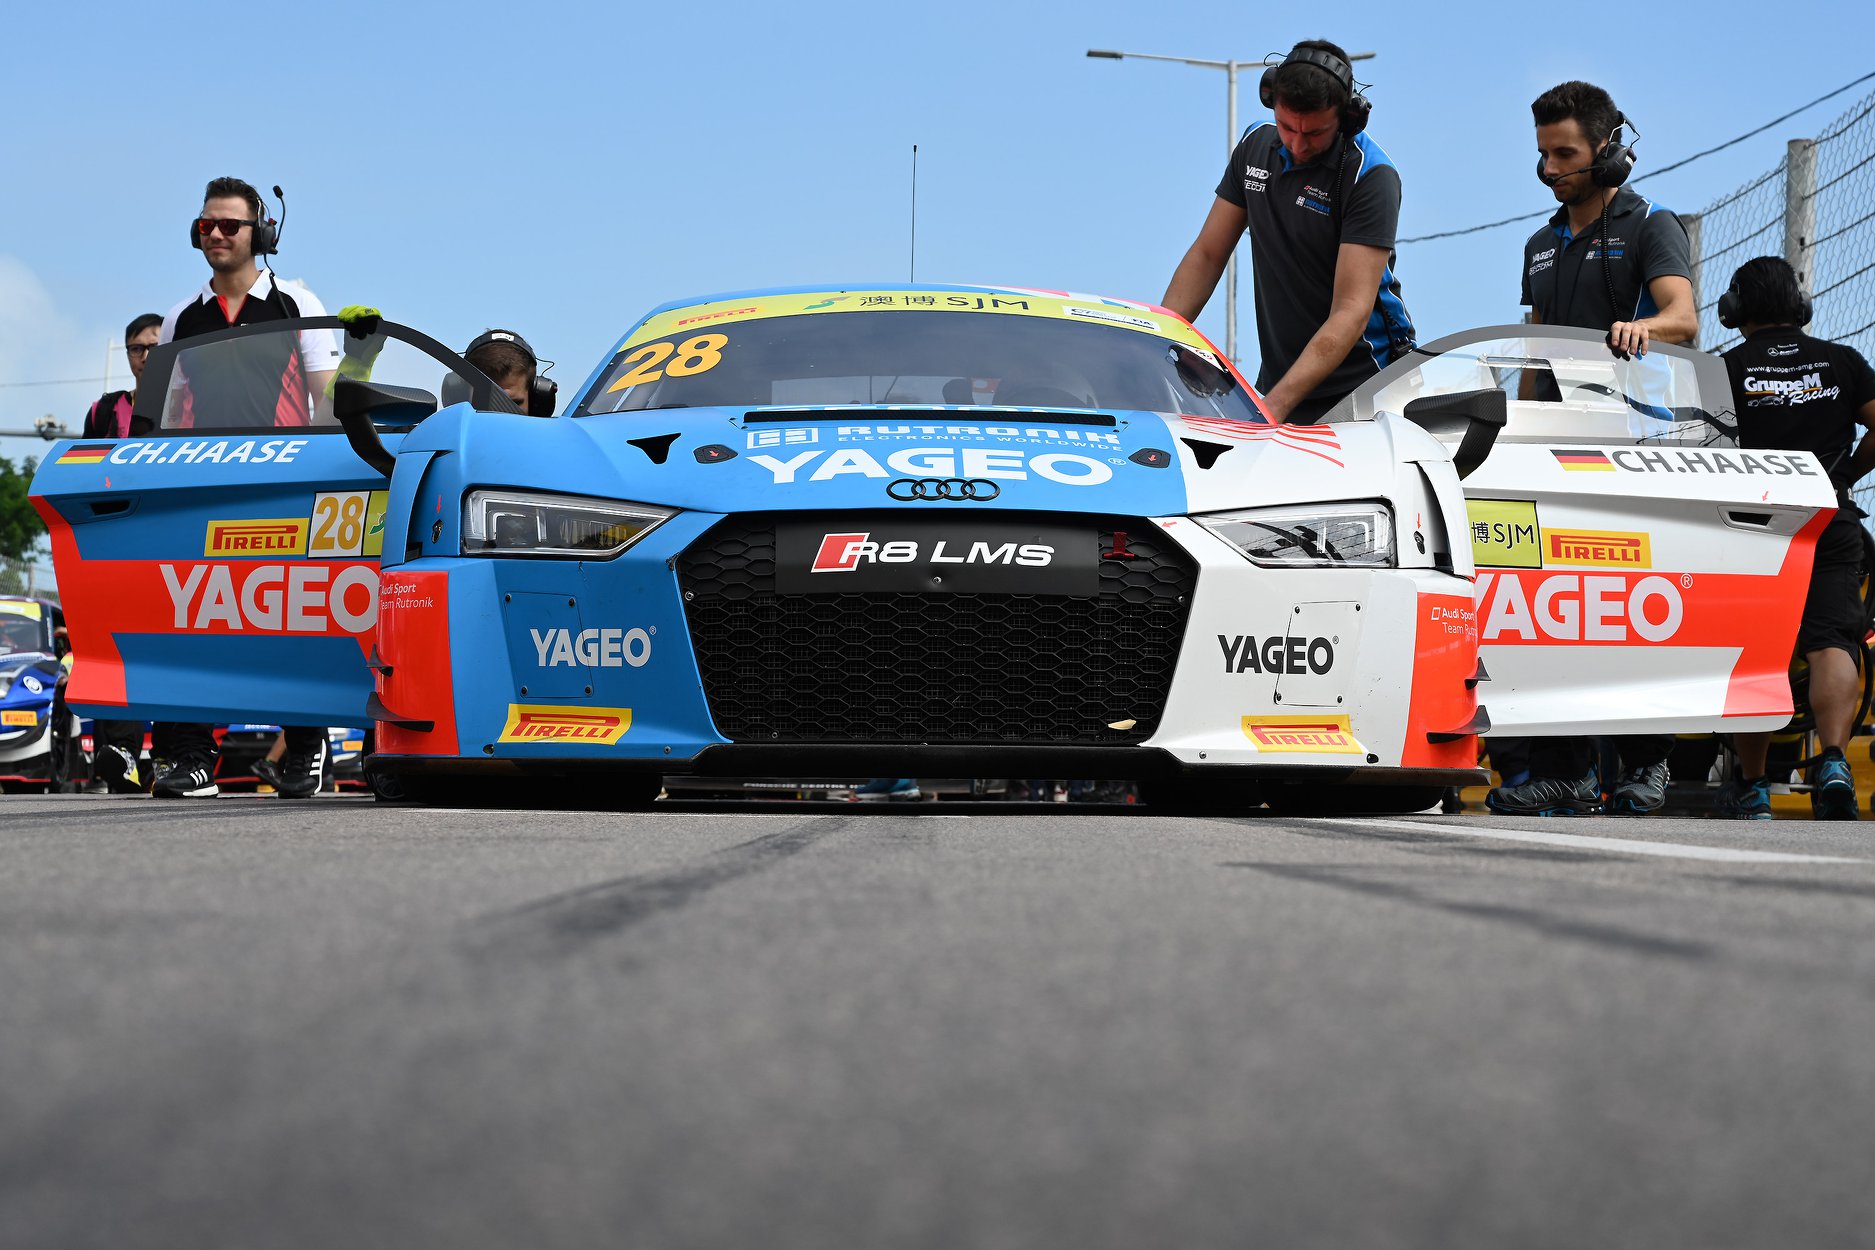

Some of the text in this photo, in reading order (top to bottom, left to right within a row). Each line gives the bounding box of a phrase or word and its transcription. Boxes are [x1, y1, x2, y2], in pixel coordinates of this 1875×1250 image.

[859, 295, 1029, 310] 澳博 SJM
[606, 333, 729, 394] 28
[1744, 373, 1821, 395] GruppeM
[1789, 386, 1840, 406] Racing
[837, 425, 1121, 445] RUTRONIK
[837, 434, 1123, 451] ELECTRONICS WORLDWIDE
[109, 440, 309, 465] CH.HAASE
[1611, 450, 1818, 476] CH.HAASE
[745, 447, 1114, 486] YAGEO
[310, 495, 364, 551] 28
[1472, 521, 1535, 550] 博 SJM
[212, 524, 299, 550] PIRELLI
[1550, 534, 1641, 563] PIRELLI
[838, 541, 1055, 567] R8 LMS
[159, 563, 380, 633] YAGEO
[394, 583, 416, 595] Sport
[395, 597, 433, 608] Rutronik
[1442, 607, 1459, 618] Audi
[1442, 622, 1463, 634] Team
[530, 628, 652, 668] YAGEO
[1217, 635, 1334, 675] YAGEO
[509, 713, 621, 739] PIRELLI
[1250, 723, 1348, 746] PIRELLI
